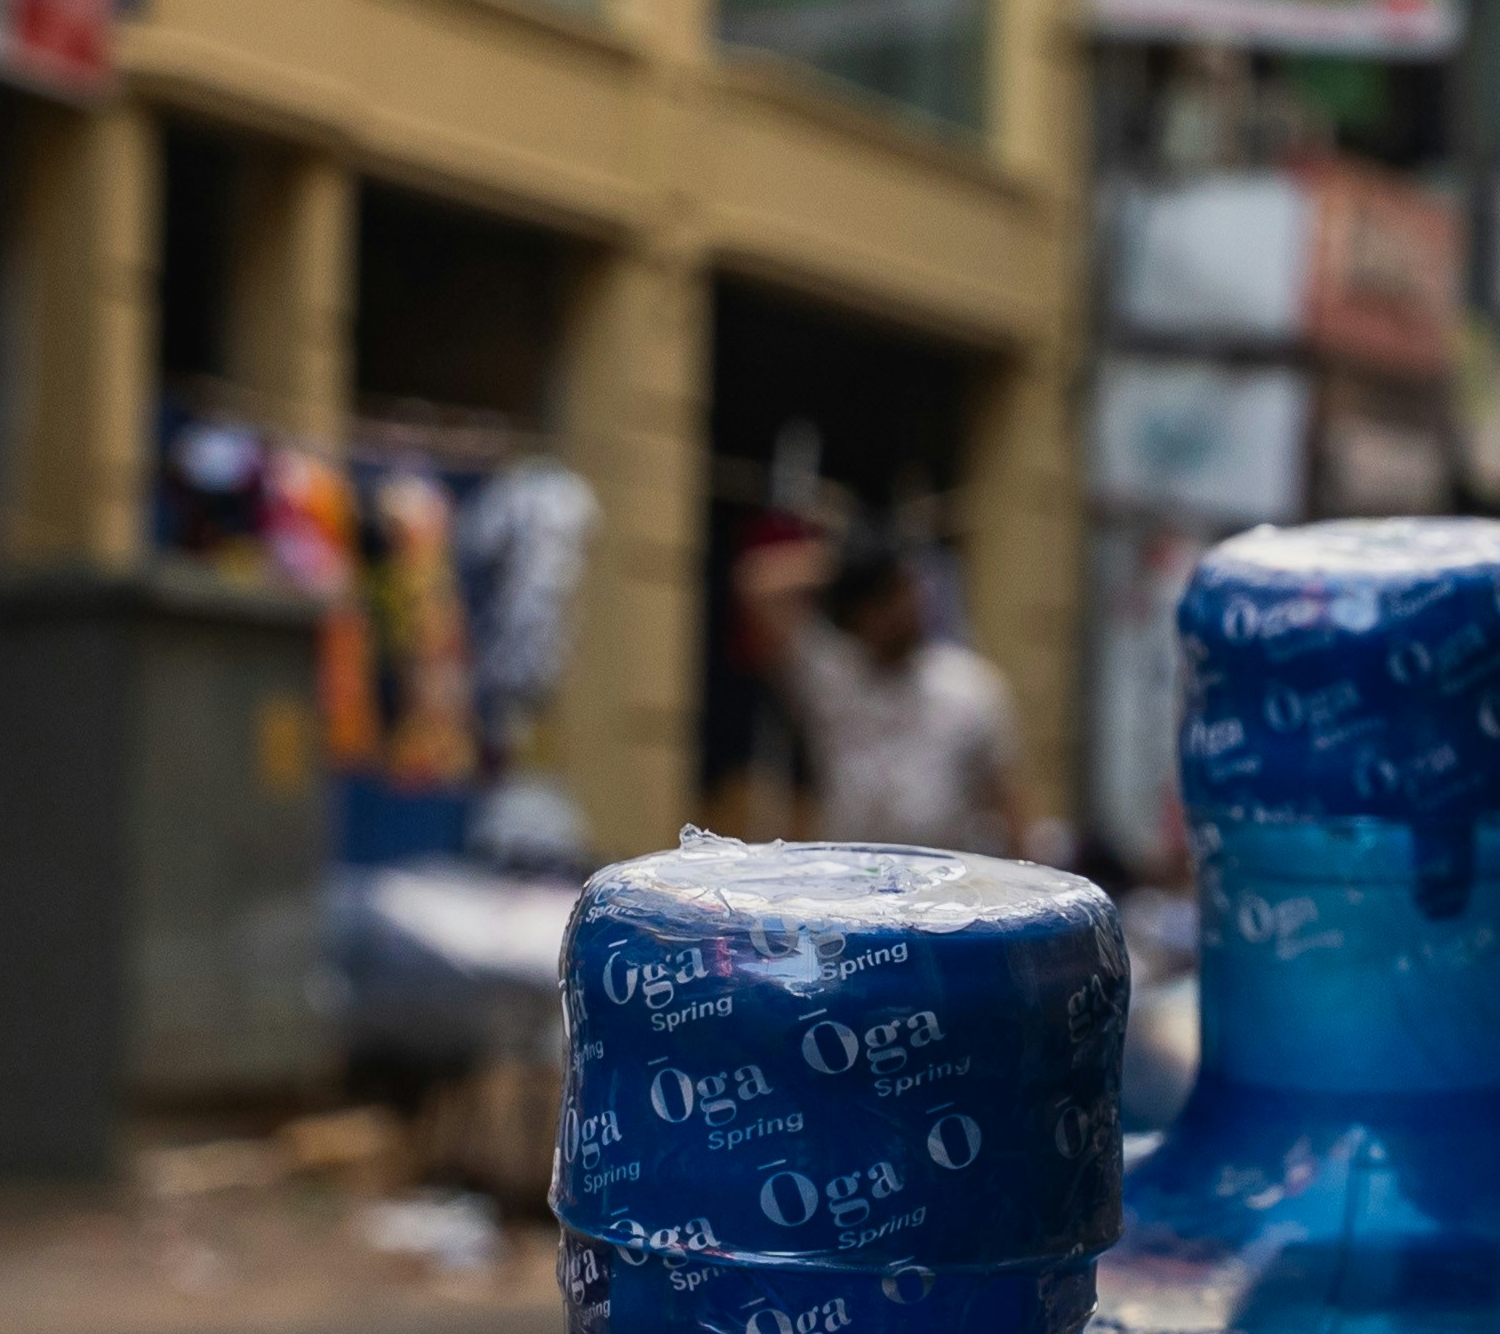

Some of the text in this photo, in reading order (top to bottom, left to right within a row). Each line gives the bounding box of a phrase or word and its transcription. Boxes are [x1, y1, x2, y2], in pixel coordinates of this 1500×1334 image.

[820, 942, 908, 981] Spring
[651, 996, 733, 1032] Spring
[874, 1055, 971, 1097] Spring
[708, 1111, 804, 1150] Spring
[583, 1158, 640, 1194] Spring
[838, 1205, 927, 1250] Spring
